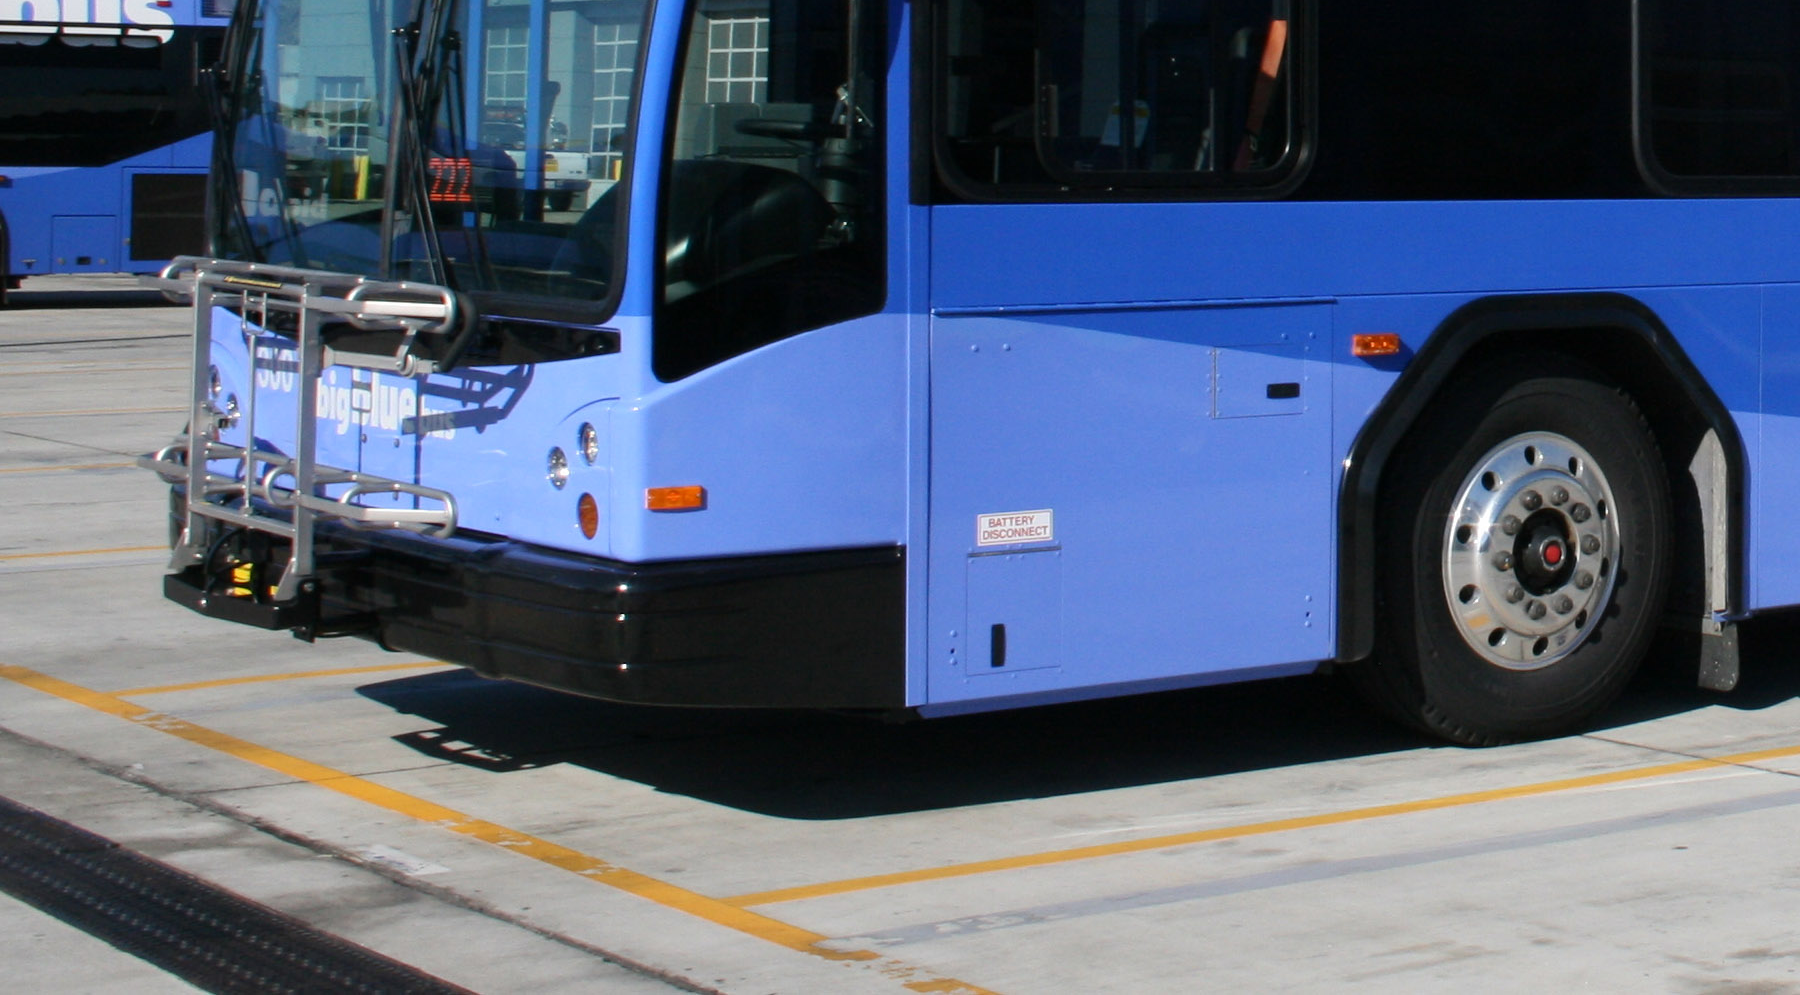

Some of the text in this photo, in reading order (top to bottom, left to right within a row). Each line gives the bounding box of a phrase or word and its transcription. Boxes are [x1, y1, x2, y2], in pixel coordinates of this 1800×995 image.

[429, 158, 472, 202] 222
[989, 515, 1035, 528] BATTERY
[983, 526, 1049, 540] DISCONNECT
